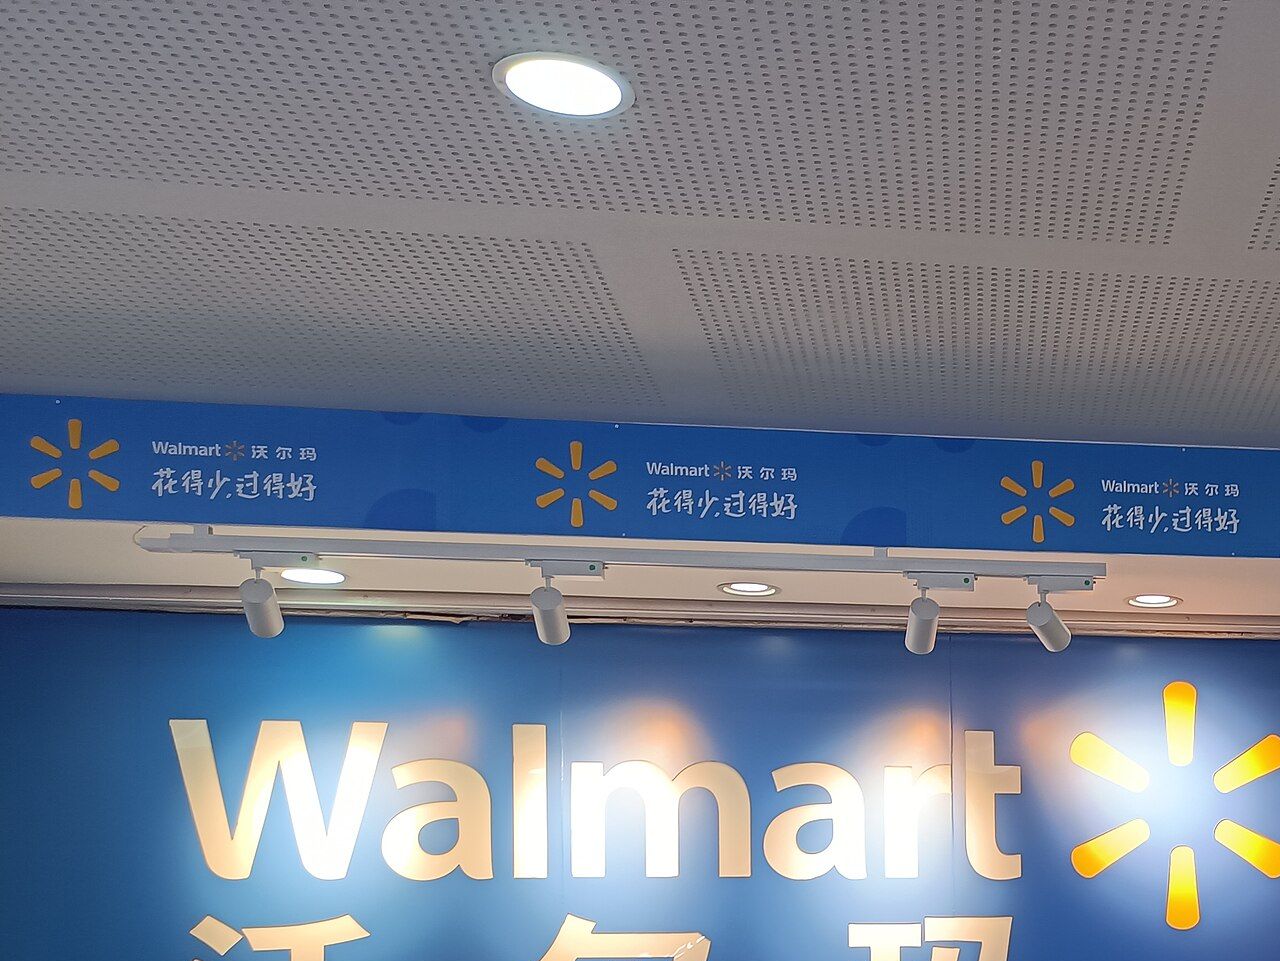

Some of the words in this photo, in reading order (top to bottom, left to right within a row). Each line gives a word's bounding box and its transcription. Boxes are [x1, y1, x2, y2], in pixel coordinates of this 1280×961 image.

[152, 441, 221, 457] Walmart
[251, 445, 317, 461] 沃尔玛
[646, 462, 710, 477] Walmart
[737, 465, 798, 482] 沃尔玛
[1101, 480, 1160, 494] Walmart
[1184, 483, 1240, 497] 沃尔玛
[170, 717, 1022, 881] Walmart
